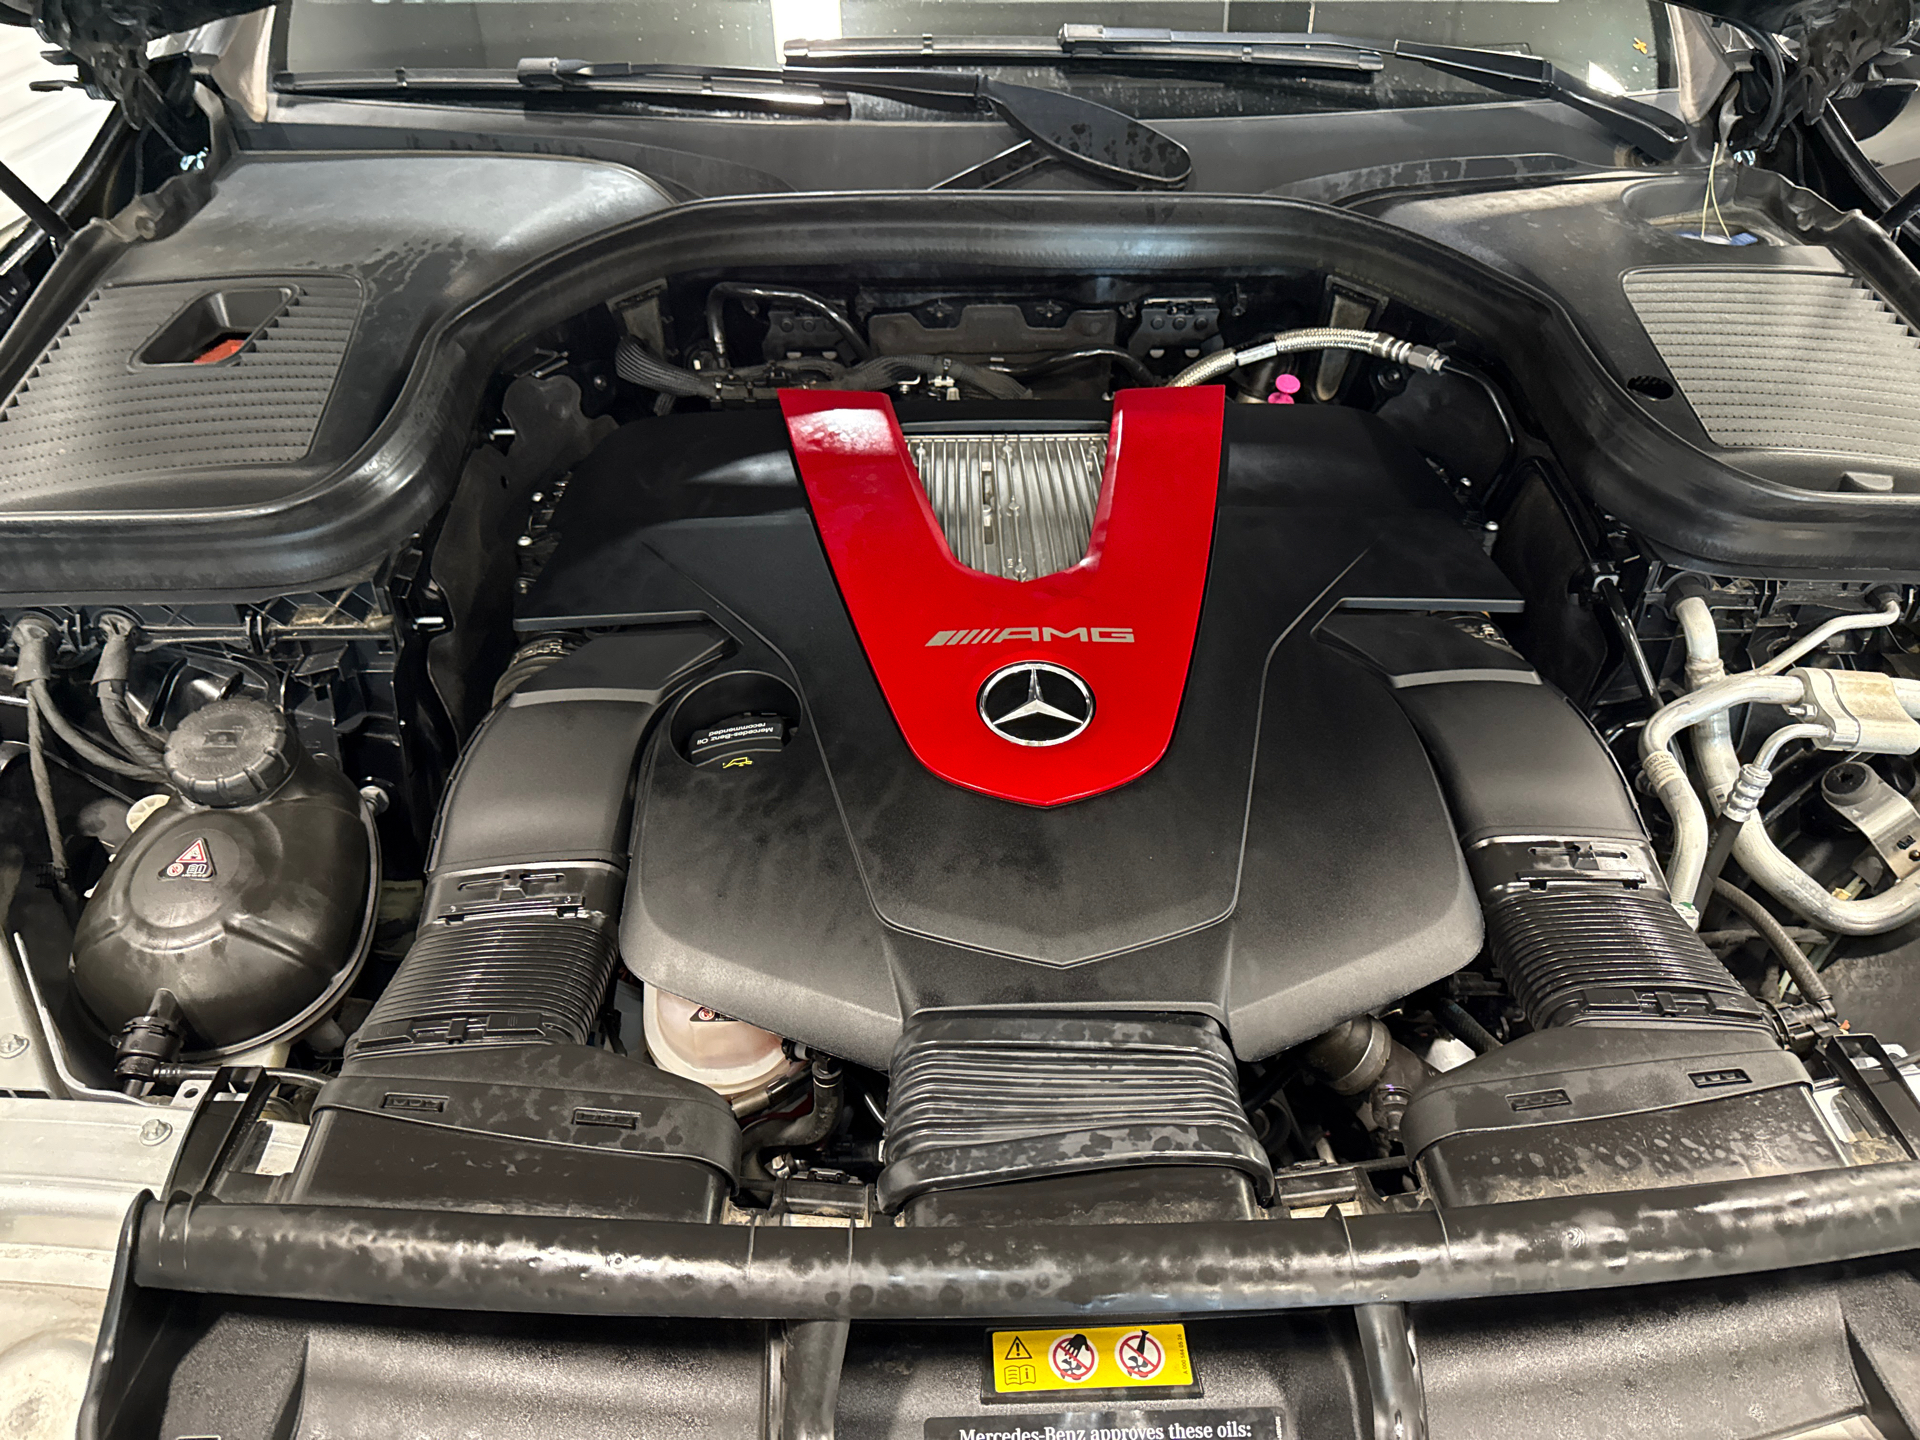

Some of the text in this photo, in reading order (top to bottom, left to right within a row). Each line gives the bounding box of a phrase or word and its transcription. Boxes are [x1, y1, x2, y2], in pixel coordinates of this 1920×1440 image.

[992, 626, 1135, 643] AMG
[709, 722, 766, 736] recommended
[710, 727, 774, 741] Mercedes-Benz
[959, 1420, 1252, 1440] Mercedes-Benz approves these oils:
